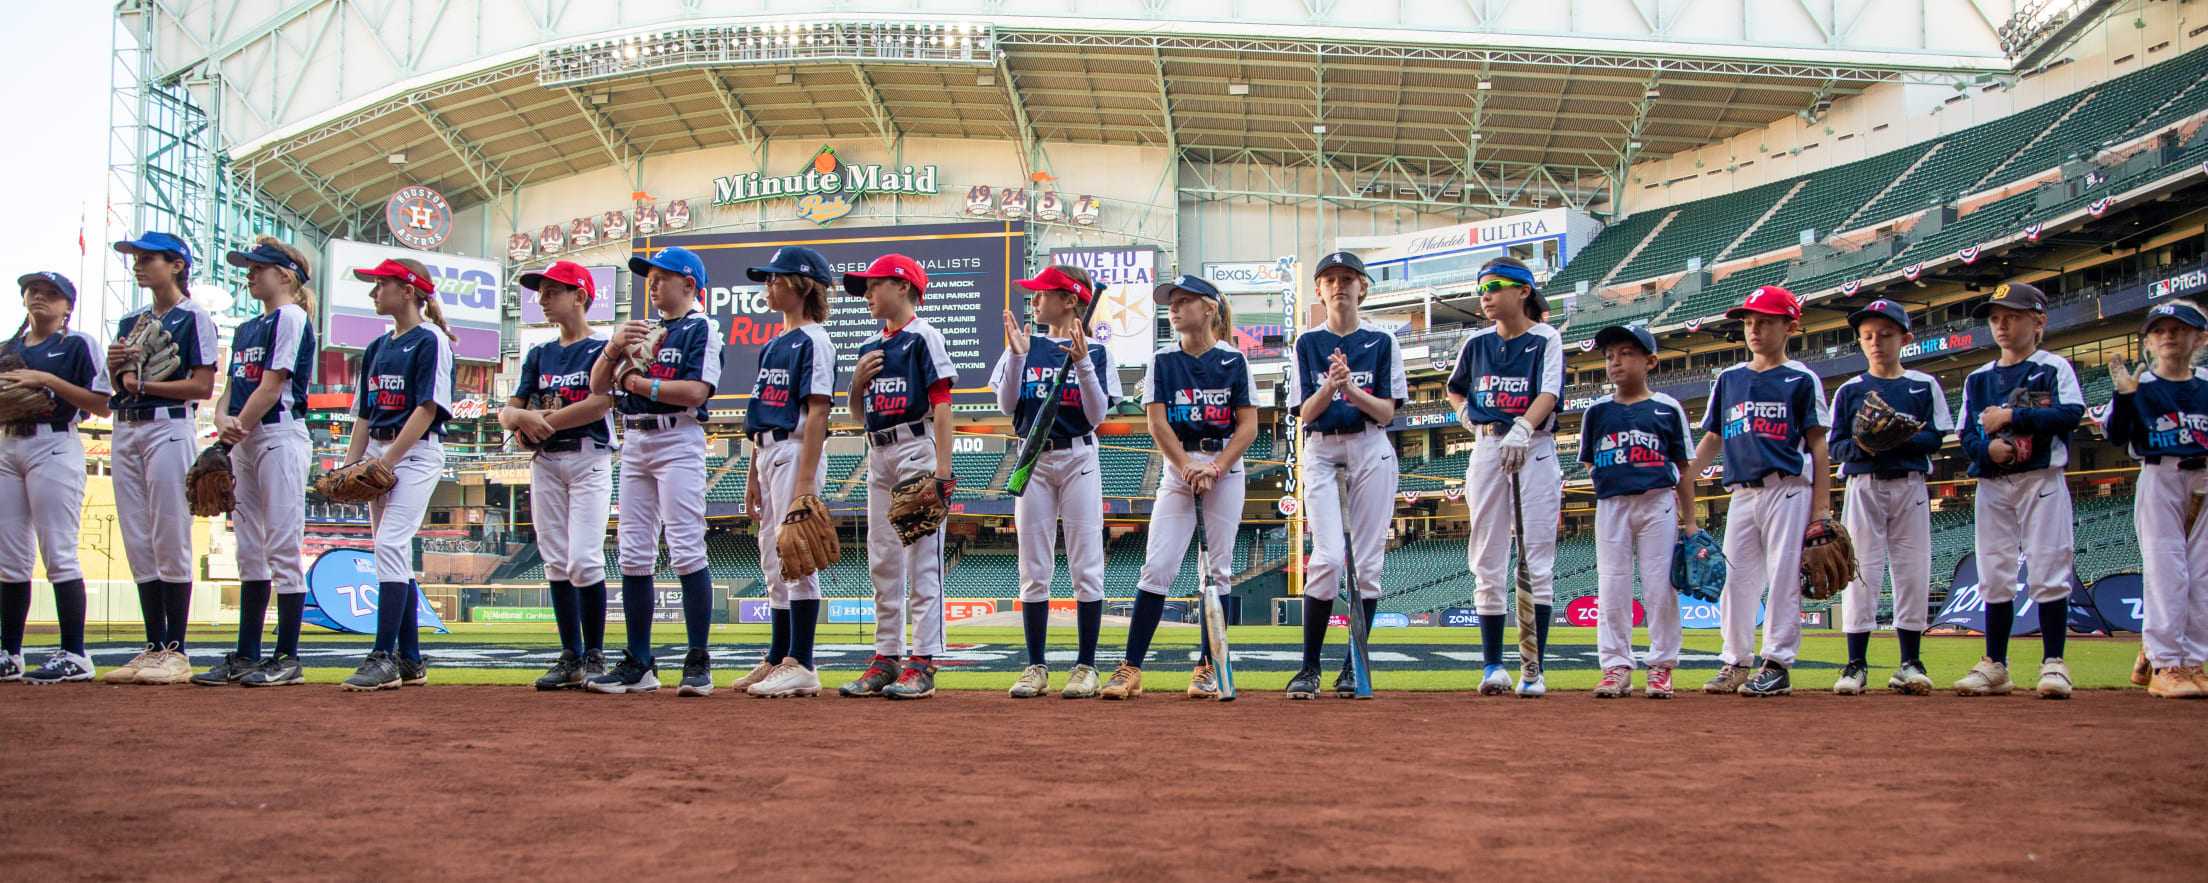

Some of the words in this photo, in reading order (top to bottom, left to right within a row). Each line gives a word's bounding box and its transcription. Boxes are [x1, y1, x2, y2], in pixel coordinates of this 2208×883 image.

[712, 168, 842, 206] Minute
[845, 164, 939, 195] Maid
[396, 188, 447, 210] HOUSTON
[967, 185, 991, 204] 49
[1001, 187, 1025, 206] 24
[1043, 190, 1055, 209] 5
[1079, 194, 1092, 213] 7
[409, 205, 433, 229] H
[635, 203, 657, 223] 34
[666, 199, 688, 218] 42
[796, 194, 851, 222] Park
[571, 216, 593, 235] 25
[603, 210, 625, 228] 33
[397, 228, 443, 246] ASTROS
[509, 233, 531, 251] 32
[540, 224, 561, 242] 40
[1407, 233, 1465, 254] Michelob
[1482, 219, 1549, 243] ULTRA
[916, 257, 981, 269] NALISTS
[1110, 251, 1136, 268] TU
[1088, 268, 1154, 285] RELLA!
[1209, 265, 1252, 281] Texas
[1258, 264, 1280, 280] Ba
[2170, 269, 2208, 293] Pitch
[949, 280, 975, 288] MOCK
[710, 285, 777, 315] Pitc
[842, 307, 872, 315] FINKEL
[1899, 342, 1921, 358] itch
[1921, 338, 1940, 354] Hit
[1938, 337, 1948, 351] &
[1949, 333, 1973, 348] Run
[550, 370, 590, 387] Pitch
[756, 368, 790, 385] Pitch
[1489, 375, 1529, 392] Pitch
[377, 390, 406, 406] Run
[761, 385, 789, 402] Run
[1035, 383, 1048, 399] &
[1484, 392, 1496, 408] &
[1496, 391, 1529, 408] Run
[451, 399, 489, 418] Cola
[874, 394, 908, 412] Run
[1744, 401, 1787, 418] Pitch
[1167, 405, 1194, 424] Hit
[1190, 406, 1203, 422] &
[1421, 413, 1446, 425] Pitch
[1724, 418, 1745, 440] Hit
[1743, 417, 1752, 433] &
[1752, 417, 1788, 434] Run
[952, 438, 984, 452] ADO
[2148, 429, 2180, 448] Hit
[2179, 428, 2194, 445] &
[1594, 448, 1617, 468] Hit
[1614, 449, 1628, 465] &
[487, 468, 531, 478] PLUCKE
[491, 611, 523, 620] National
[843, 606, 875, 617] HON
[1448, 615, 1480, 624] ZONE
[1681, 605, 1721, 620] ZON
